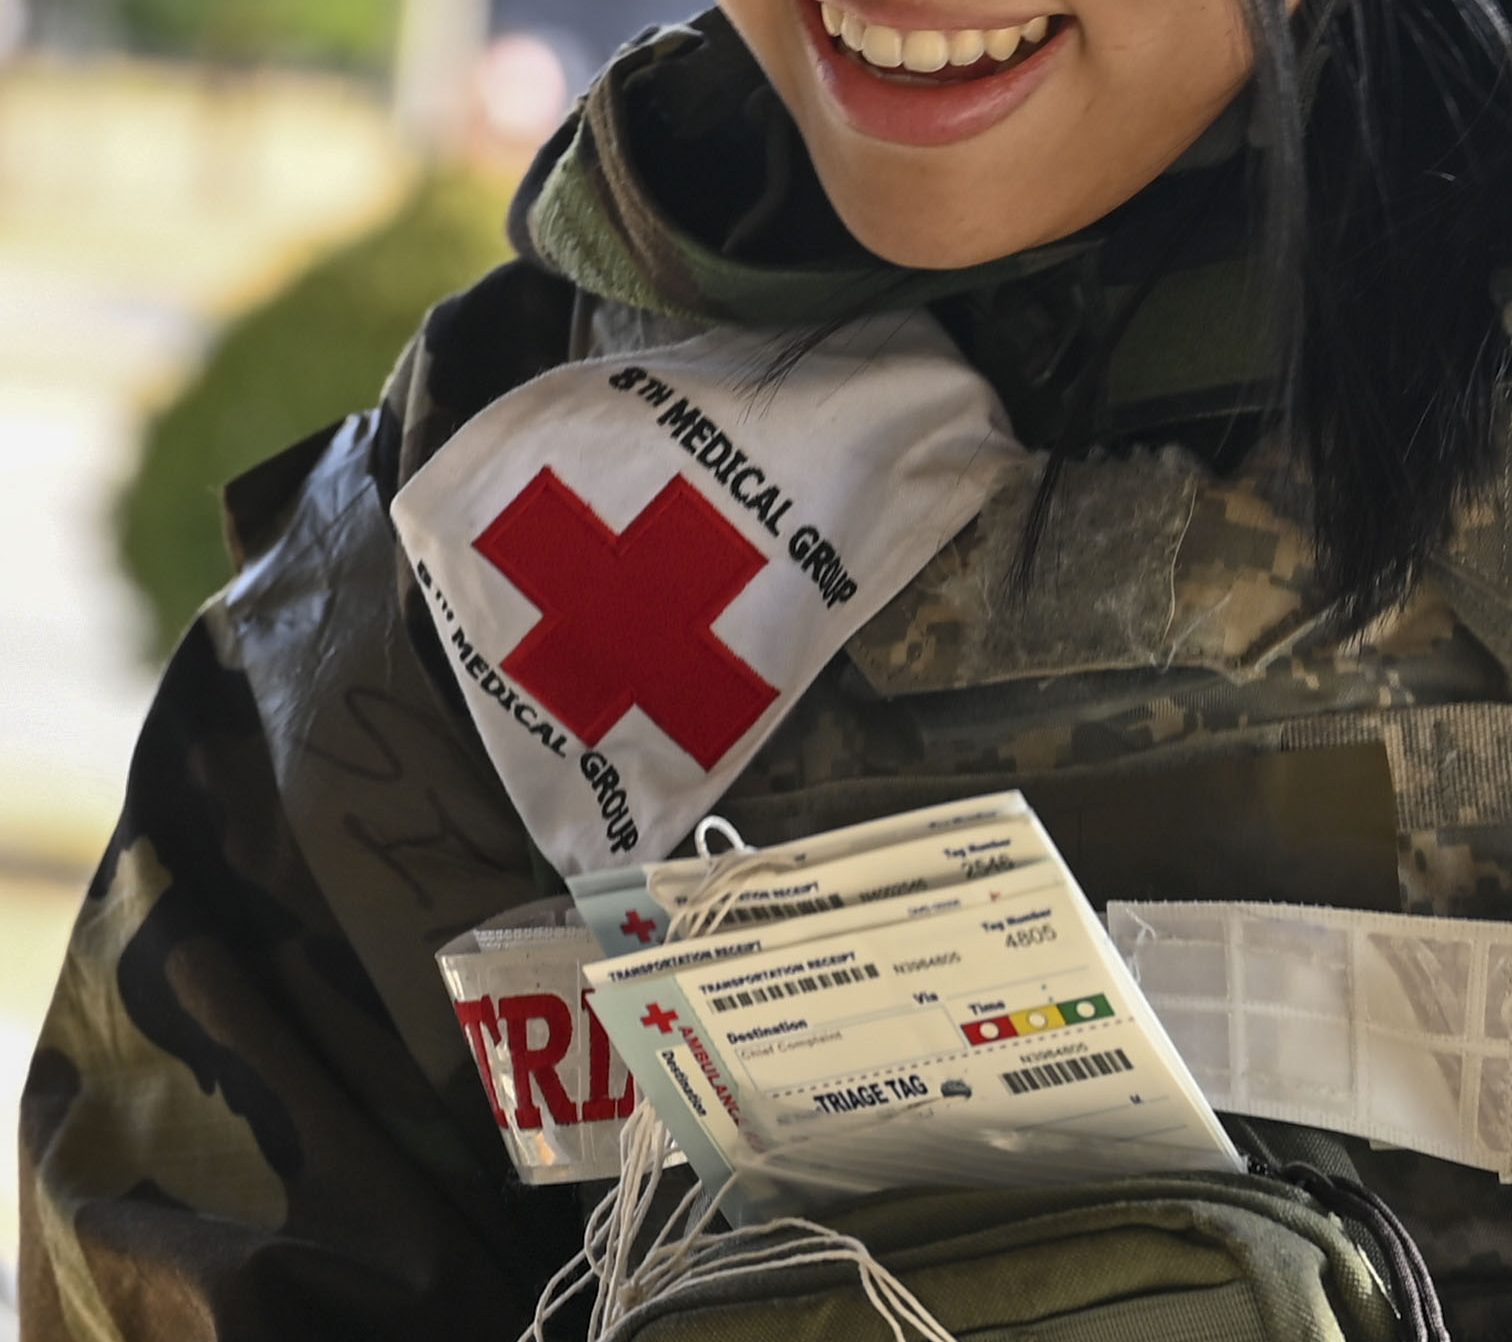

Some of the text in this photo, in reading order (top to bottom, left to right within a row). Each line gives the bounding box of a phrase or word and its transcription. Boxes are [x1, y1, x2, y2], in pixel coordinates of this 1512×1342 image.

[609, 367, 675, 408] 8TH
[656, 396, 794, 538] MEDICAL
[451, 626, 568, 758] MEDICAL
[580, 751, 639, 854] GROUP
[980, 908, 1052, 934] Tag Number
[1006, 924, 1057, 950] 4805
[608, 940, 763, 983] TRANSPORTATION RECEIPT
[699, 952, 856, 995] TRANSPORTATION RECEIPT
[913, 991, 939, 1007] Via
[968, 999, 1006, 1016] Time
[727, 1018, 809, 1045] Destination
[741, 1031, 843, 1060] Chief Complaint
[813, 1074, 929, 1114] TRIAGE TAG
